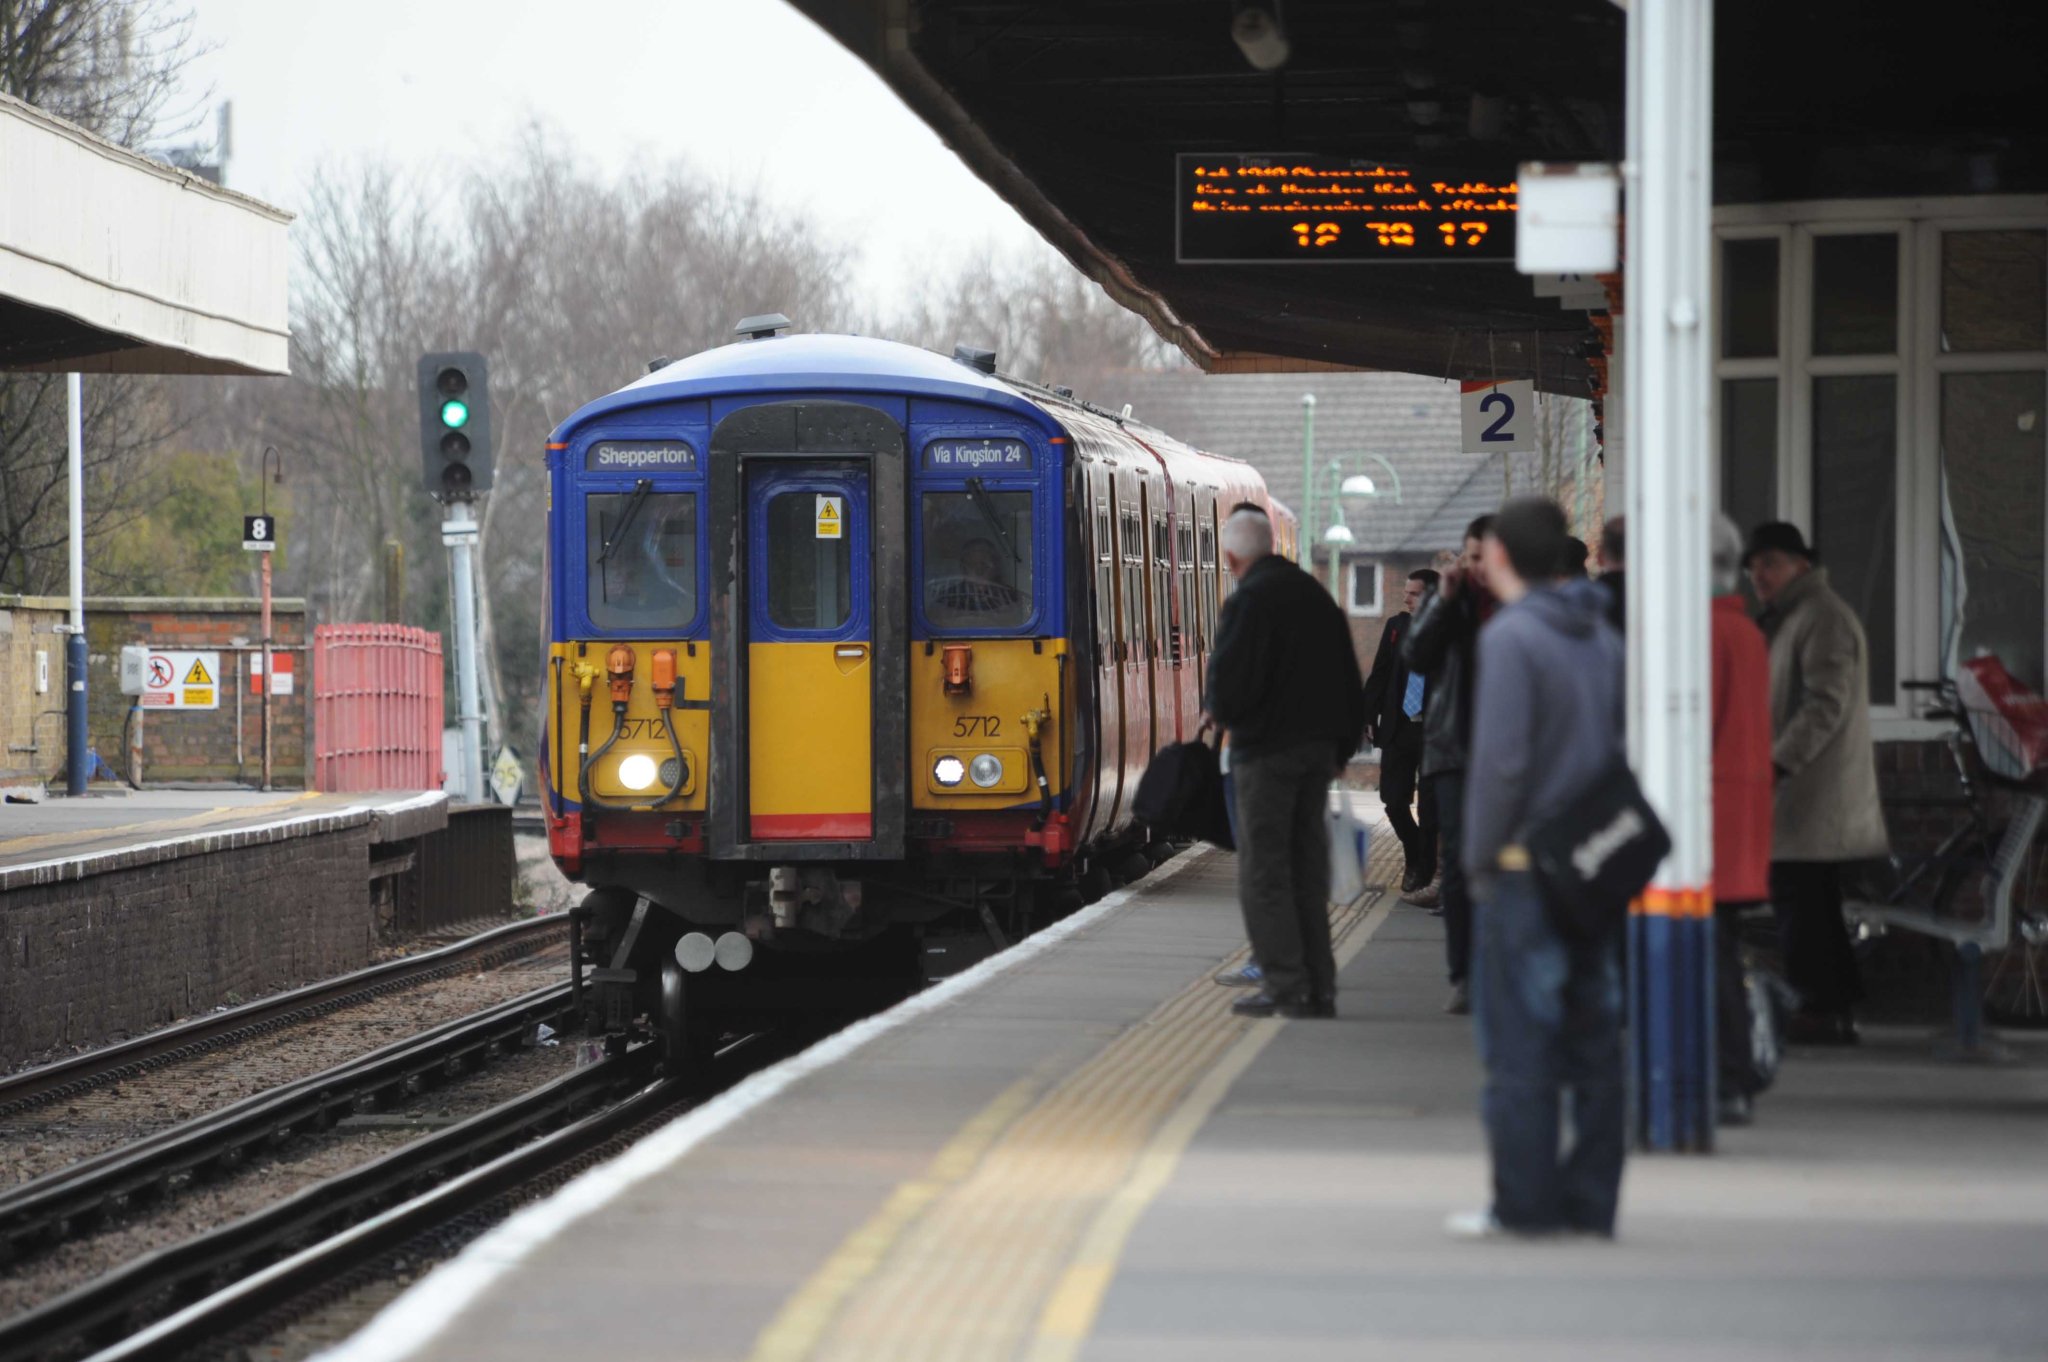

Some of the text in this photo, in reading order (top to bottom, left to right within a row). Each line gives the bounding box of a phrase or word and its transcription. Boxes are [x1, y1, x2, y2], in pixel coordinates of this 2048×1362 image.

[1480, 392, 1515, 442] 2
[598, 446, 688, 467] Shepperton
[933, 445, 1021, 467] Via Kingston 24
[252, 518, 267, 540] 8
[953, 715, 1001, 738] 5712
